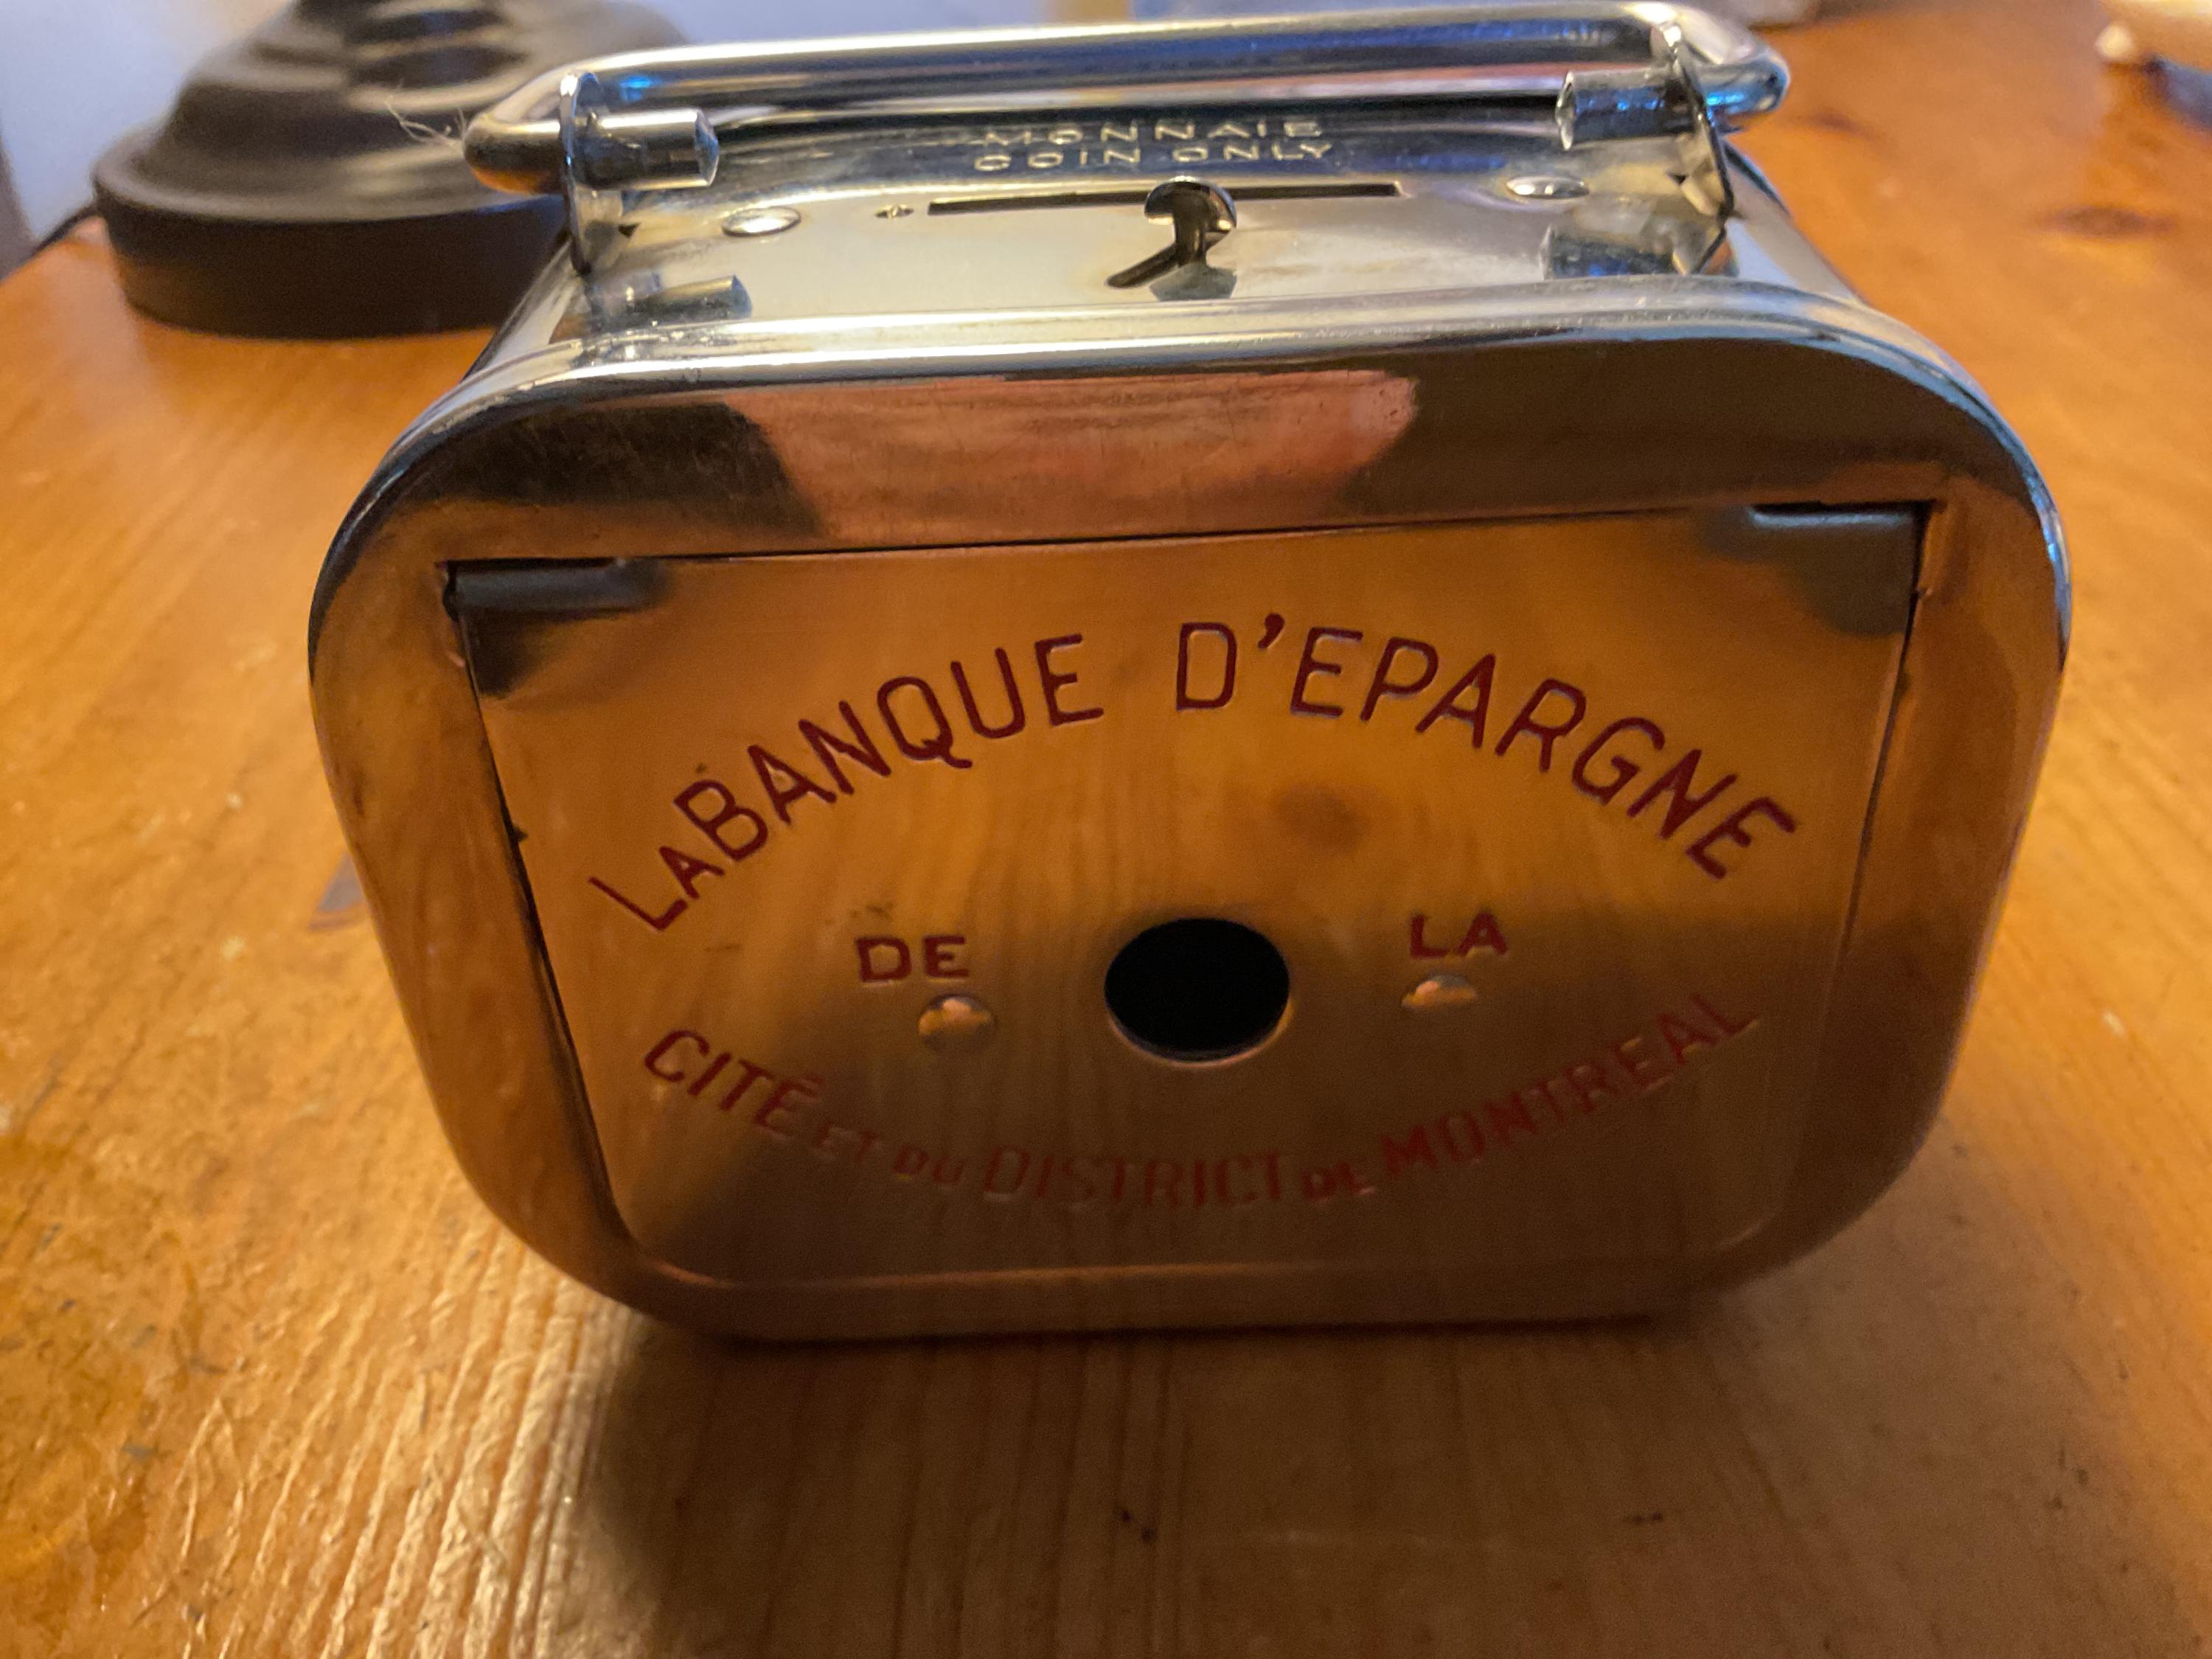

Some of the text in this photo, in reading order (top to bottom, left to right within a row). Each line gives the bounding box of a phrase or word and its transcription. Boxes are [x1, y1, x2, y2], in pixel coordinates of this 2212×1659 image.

[973, 143, 1331, 172] COIN ONLY
[984, 120, 1322, 146] MONNAIE
[673, 633, 1105, 861] BANQUE
[855, 911, 1509, 983] DE LA
[894, 1143, 964, 1186] DU
[979, 1144, 1284, 1209] DISTRICT
